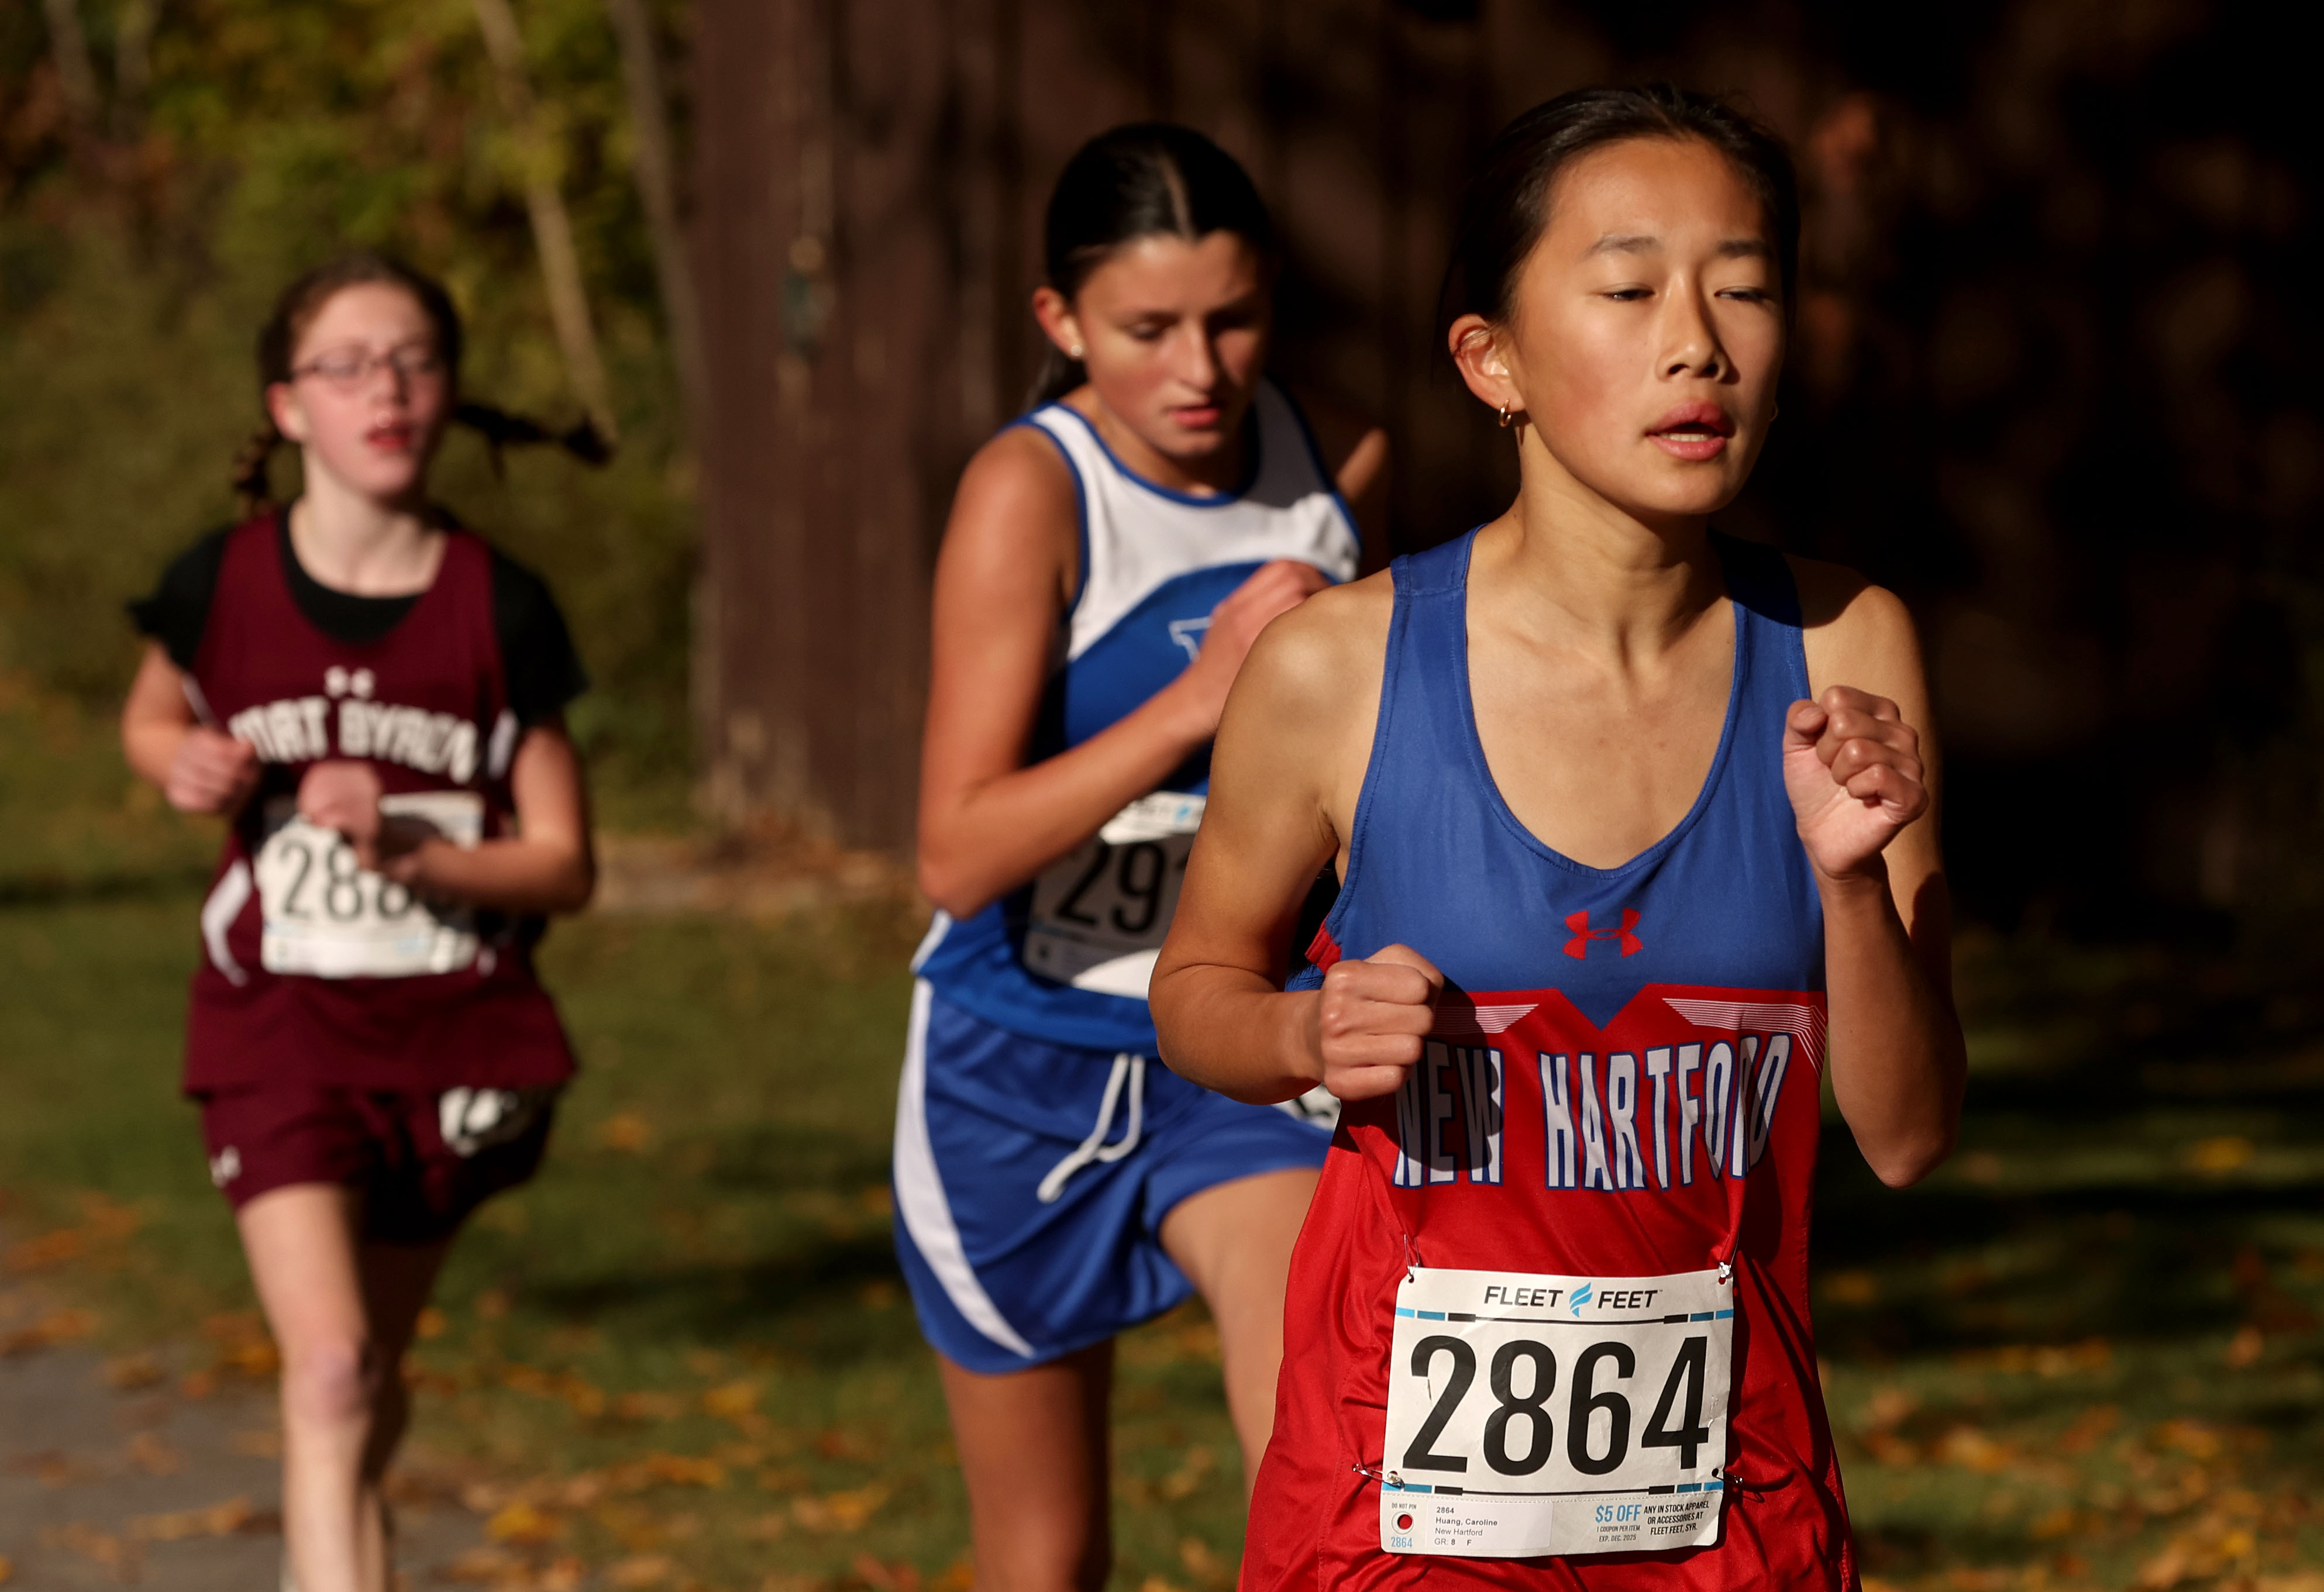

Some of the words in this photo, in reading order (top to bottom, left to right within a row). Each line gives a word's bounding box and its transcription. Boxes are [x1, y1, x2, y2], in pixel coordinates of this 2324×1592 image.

[1052, 841, 1192, 934] 29
[1392, 1039, 1505, 1189] NEW
[1538, 1032, 1793, 1193] HARTFORD
[1483, 1286, 1564, 1308] FLEET
[1597, 1290, 1659, 1309] FEET
[1402, 1335, 1709, 1477] 2864
[1595, 1505, 1613, 1524] $5
[1617, 1504, 1642, 1521] OFF
[1644, 1505, 1658, 1514] ANY
[1658, 1505, 1664, 1513] IN
[1665, 1504, 1685, 1512] STOCK
[1685, 1501, 1709, 1511] APPAREL
[1435, 1517, 1463, 1526] Huang,
[1657, 1513, 1696, 1524] ACCESSORIES
[1696, 1512, 1703, 1520] AT
[1650, 1526, 1669, 1535] FLEET
[1669, 1525, 1684, 1534] FEET,
[1685, 1523, 1698, 1532] SYR.
[1391, 1536, 1413, 1548] 2864
